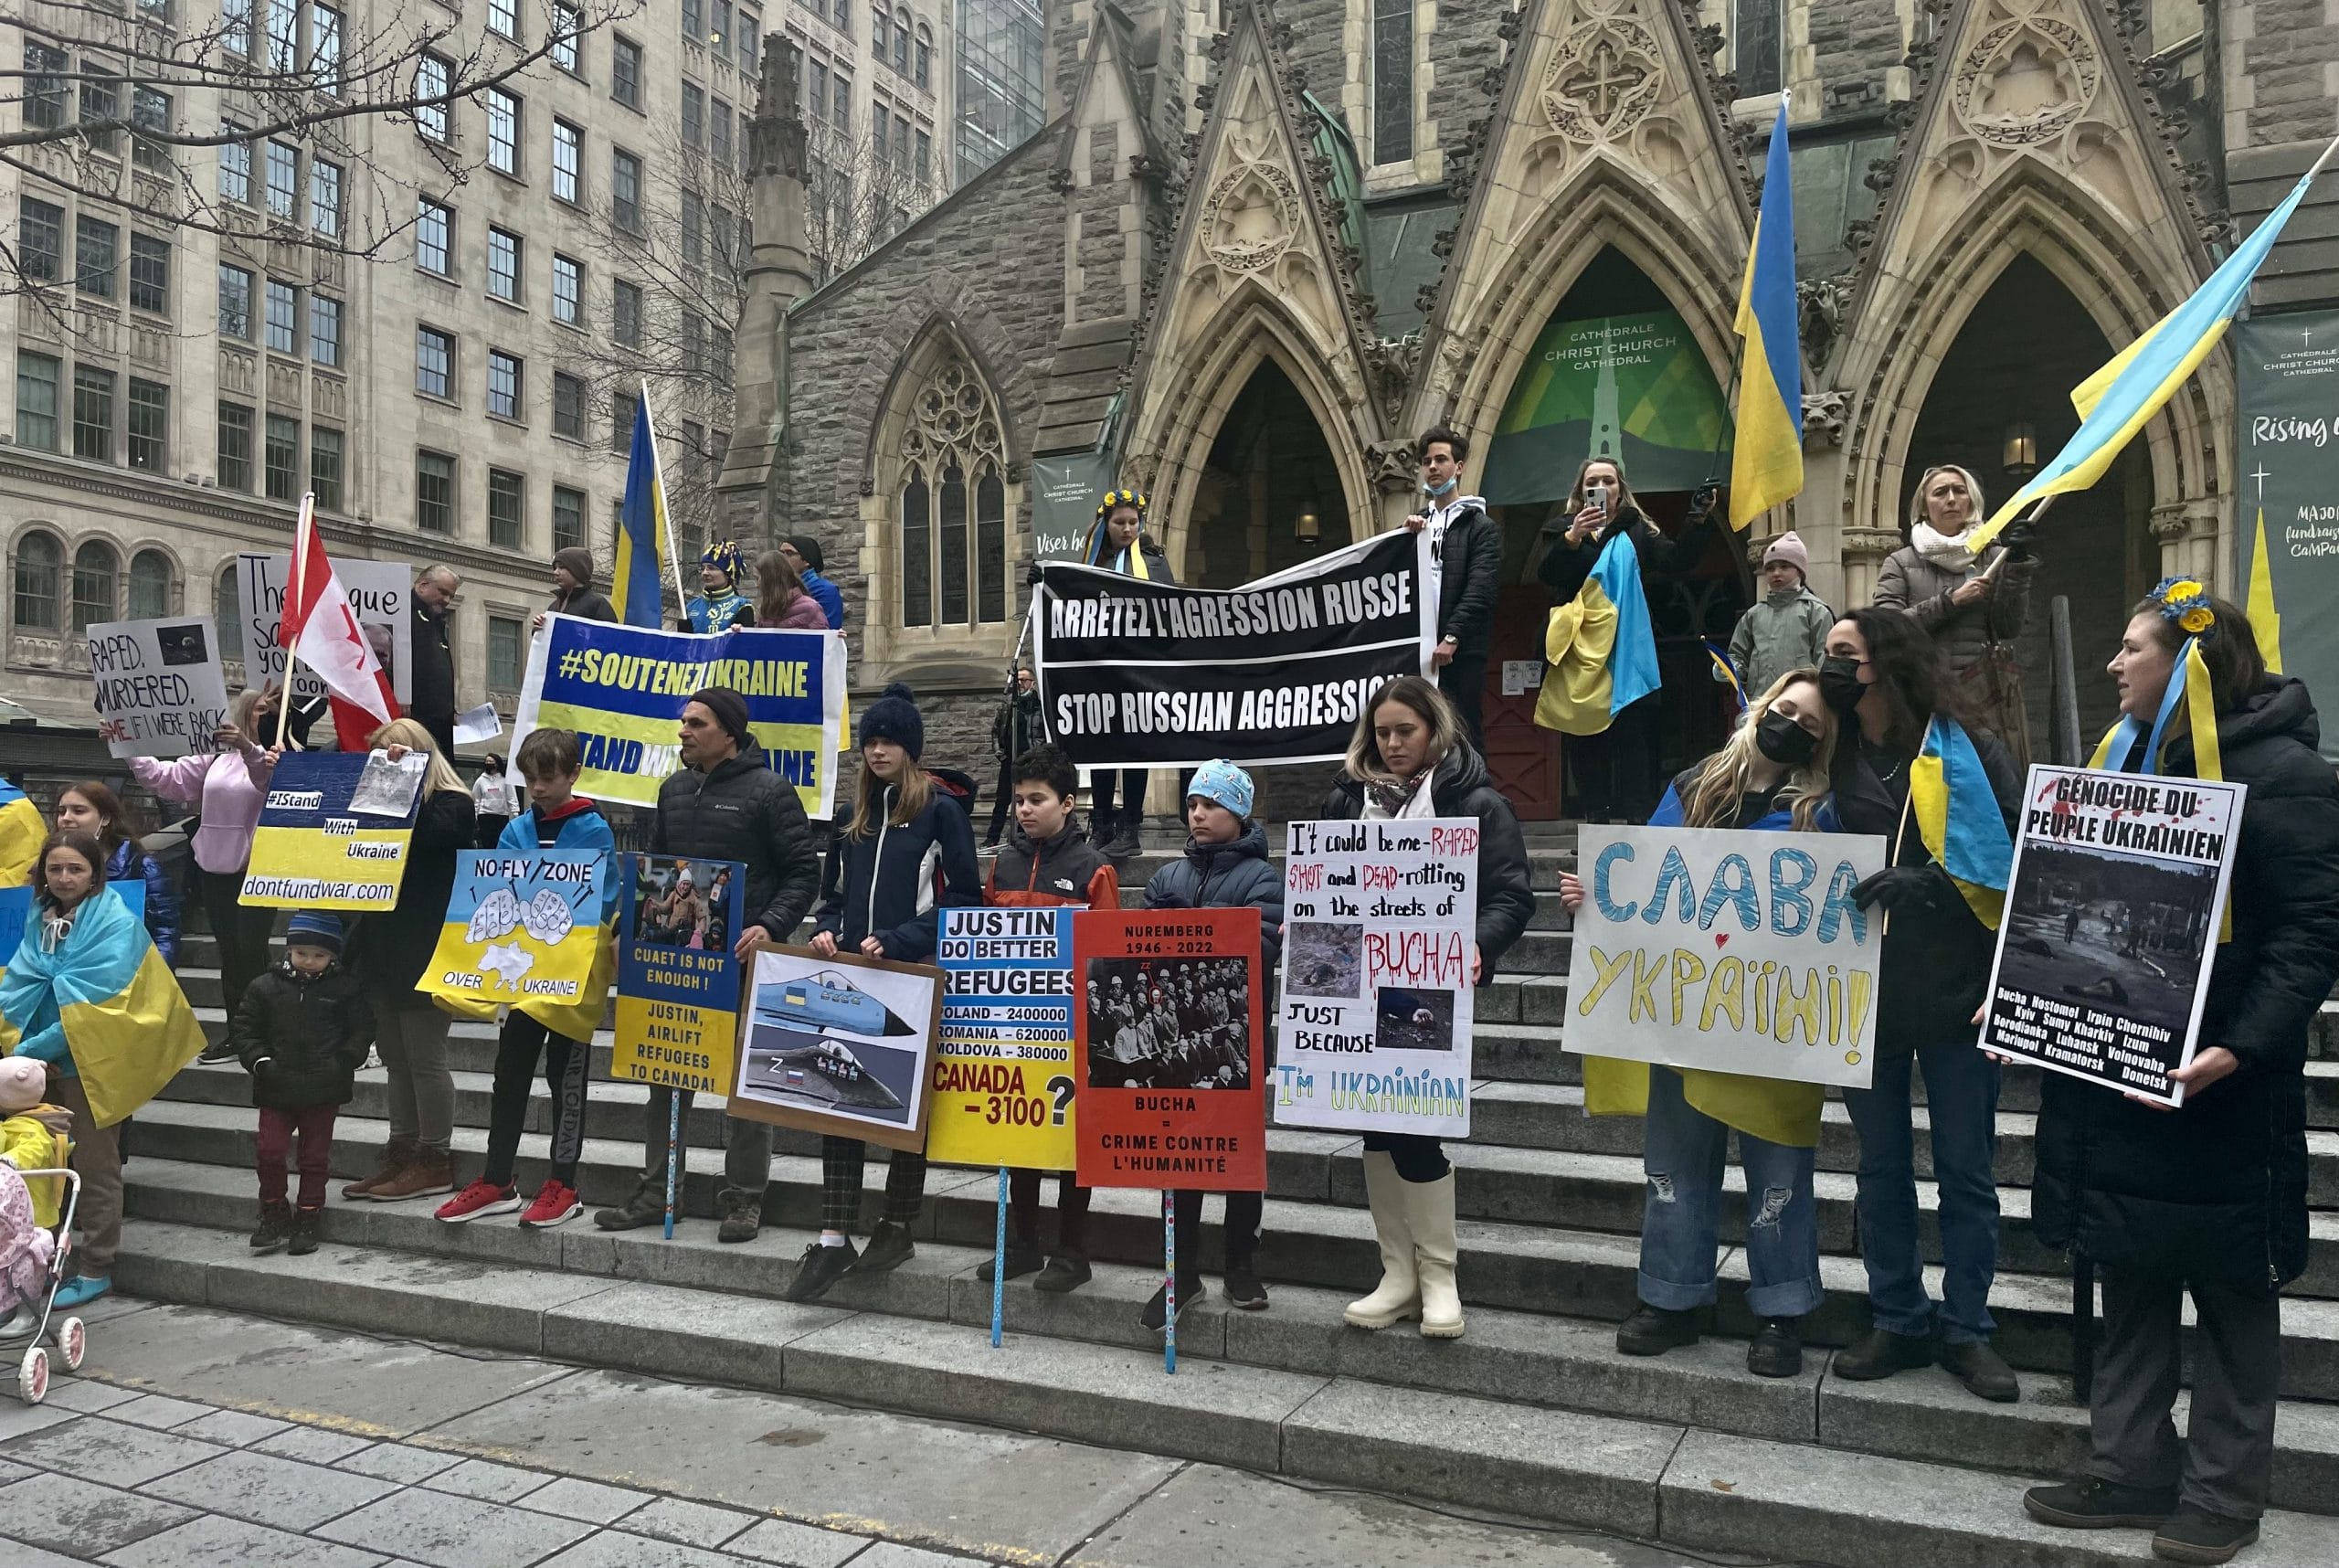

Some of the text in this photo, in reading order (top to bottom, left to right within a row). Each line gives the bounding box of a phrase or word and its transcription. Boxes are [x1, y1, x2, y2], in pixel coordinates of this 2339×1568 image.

[1544, 336, 1677, 361] CHRIST CHURCH
[1574, 355, 1651, 370] CATHEDRAL
[2263, 360, 2302, 370] CHRIST
[2283, 366, 2334, 376] CATHEDRAL
[2252, 416, 2328, 447] Rising
[1037, 533, 1068, 555] Viser
[1051, 569, 1412, 639] ARRÊTEZ L'AGRESSION RUSSE
[90, 635, 145, 673] RAPED.
[96, 673, 195, 712] MURDERED.
[1057, 673, 1404, 736] STOP RUSSIAN AGGRESSI
[130, 716, 143, 739] IF
[143, 715, 153, 738] I
[152, 713, 186, 736] WERE
[189, 709, 226, 734] BACK
[268, 793, 320, 808] #IStand
[2057, 774, 2198, 818] GÉNOCIDE DU
[324, 821, 355, 835] With
[1326, 824, 1367, 853] could
[1378, 825, 1393, 852] be
[2027, 810, 2224, 862] PEUPLE UKRAINIEN
[347, 843, 397, 859] Ukraine
[543, 862, 593, 882] ZONE
[1289, 863, 1324, 894] SHOT
[1327, 865, 1357, 886] and
[244, 876, 394, 900] dontfundwar.com
[1594, 842, 1868, 947] СЛАВА
[1294, 895, 1456, 917] on the streets of
[948, 912, 1055, 937] JUSTIN
[1125, 925, 1214, 938] NUREMBERG
[941, 939, 1056, 959] DO BETTER
[1126, 942, 1161, 954] 1946
[1177, 942, 1213, 953] 2022
[634, 948, 725, 973] CUAET IS NOT
[1365, 932, 1465, 989] BUCHA
[443, 971, 483, 989] OVER
[523, 979, 578, 995] UKRAINE!
[647, 969, 699, 990] ENOUGH
[648, 1003, 704, 1027] JUSTIN,
[940, 1007, 990, 1019] OLAND
[1007, 1008, 1065, 1021] 2400000
[1288, 1003, 1347, 1026] JUST
[1997, 987, 2171, 1044] Bucha Hostomel Irpin Chernihiv
[648, 1024, 702, 1046] AIRLIFT
[938, 1026, 999, 1040] ROMANIA
[1016, 1029, 1066, 1042] 620000
[2015, 1005, 2150, 1053] Kyiv Sumy Kharkiv Izum
[937, 1042, 1001, 1057] MOLDOVA
[1017, 1045, 1067, 1061] 380000
[1295, 1031, 1373, 1054] BECAUSE
[2056, 1031, 2100, 1054] Luhansk
[2108, 1045, 2165, 1074] Volnovaha
[638, 1044, 710, 1069] REFUGEES
[1996, 1029, 2168, 1091] Mariupol Kramatorsk Donetsk
[630, 1063, 715, 1092] TO CANADA!
[932, 1062, 1025, 1095] CANADA
[986, 1097, 1045, 1127] 3100
[1135, 1097, 1197, 1111] BUCHA
[558, 1081, 579, 1160] JORDAN
[1101, 1134, 1238, 1151] CRIME CONTRE
[1113, 1153, 1226, 1173] L'HUMANITÉ
